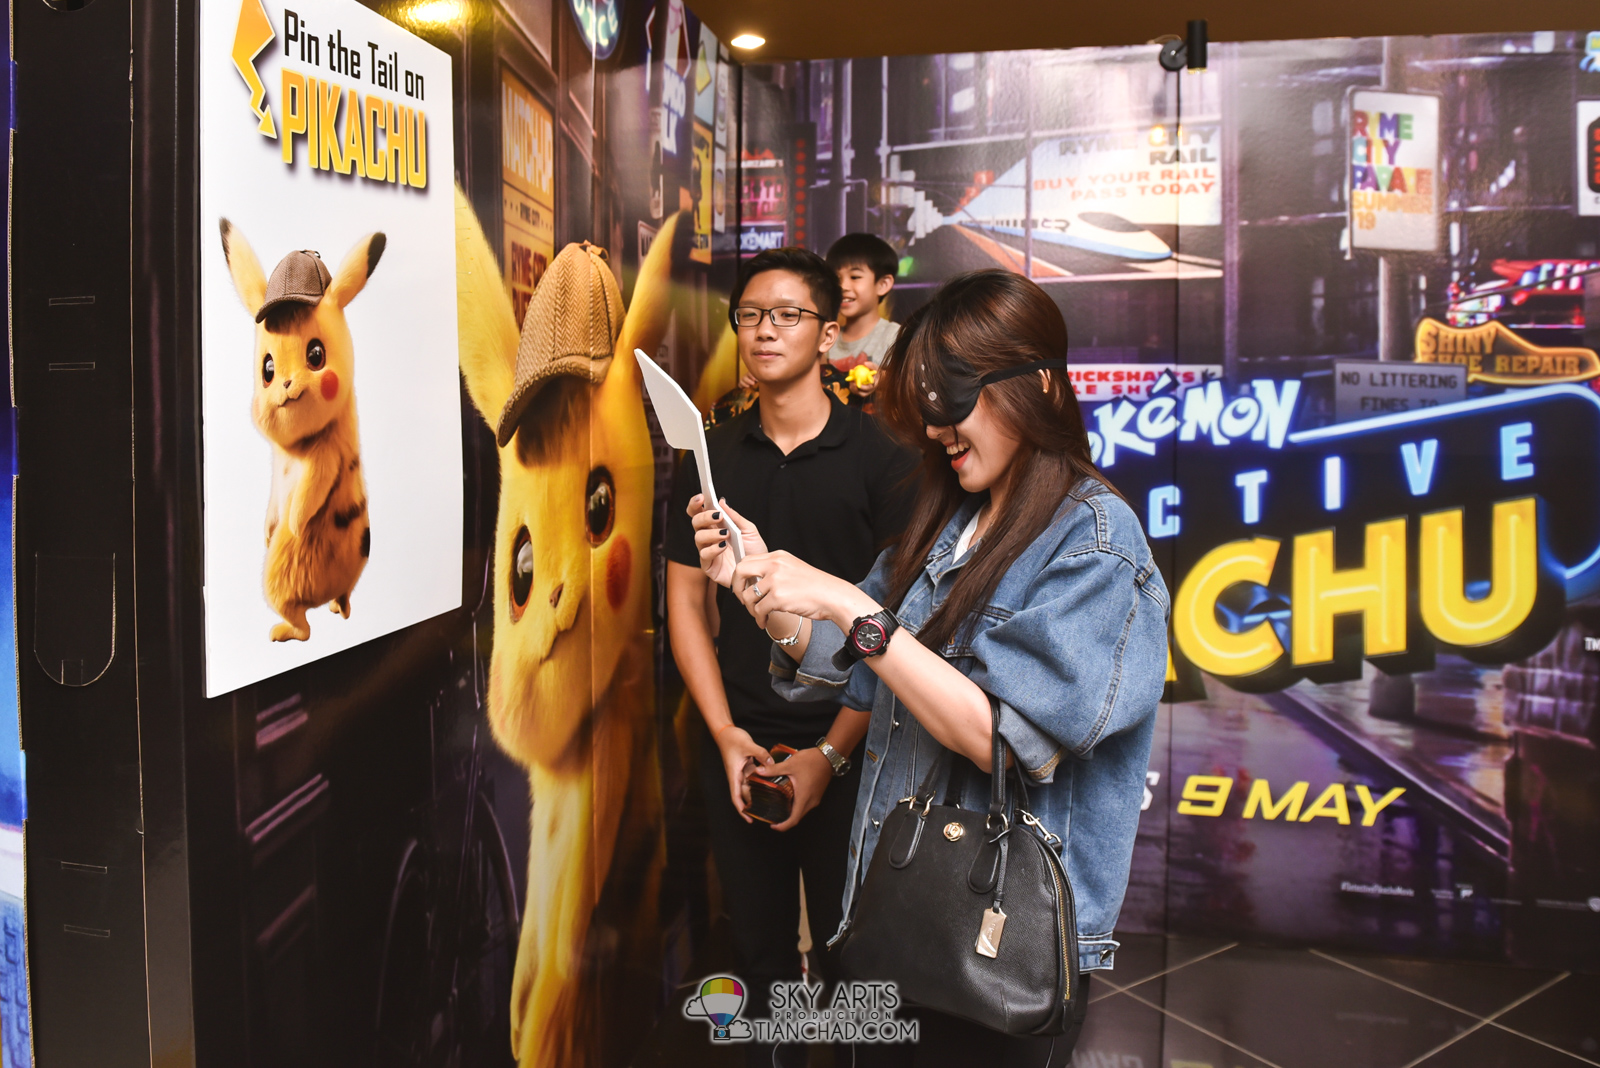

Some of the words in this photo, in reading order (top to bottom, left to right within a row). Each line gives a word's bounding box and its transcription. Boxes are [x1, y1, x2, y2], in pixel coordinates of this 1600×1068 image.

[284, 8, 319, 66] Pin
[327, 29, 361, 79] the
[367, 41, 398, 92] Tail
[405, 69, 424, 101] on
[281, 67, 427, 189] PIKACHU
[1352, 110, 1413, 140] RYME
[1149, 148, 1217, 165] RAIL
[1033, 176, 1078, 191] BUY
[1087, 171, 1150, 186] YOUR
[1160, 167, 1216, 181] RAIL
[1070, 185, 1128, 201] PASS
[1138, 181, 1216, 197] TODAY
[1421, 327, 1499, 354] SHINY
[1495, 355, 1580, 374] REPAIR
[1341, 372, 1360, 386] NO
[1370, 372, 1458, 389] LITTERING
[1361, 397, 1409, 412] FINES
[1165, 498, 1538, 681] CHU
[1177, 775, 1234, 817] 9
[1242, 778, 1407, 827] MAY
